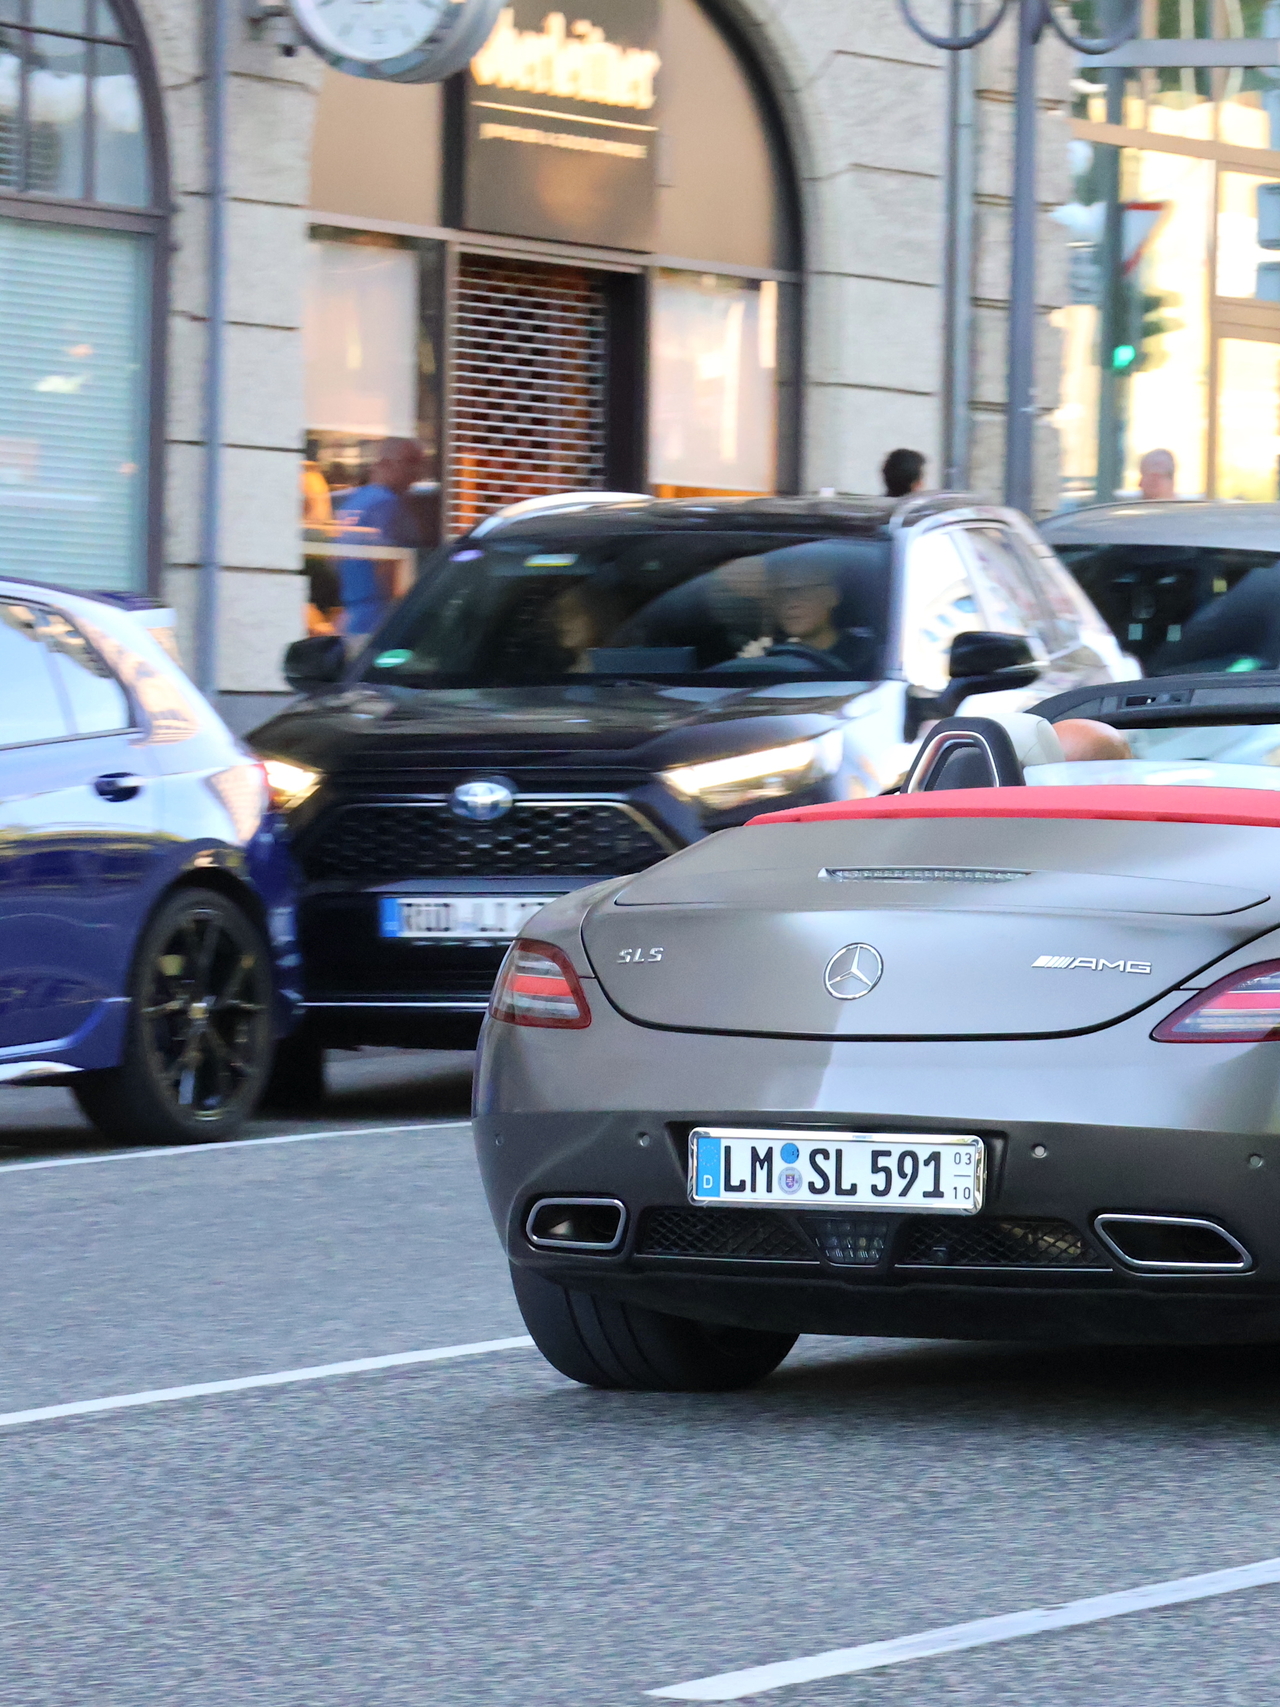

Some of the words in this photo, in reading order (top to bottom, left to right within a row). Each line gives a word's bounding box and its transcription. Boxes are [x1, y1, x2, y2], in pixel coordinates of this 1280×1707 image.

[617, 947, 664, 963] SLS
[1069, 957, 1151, 974] AMG
[953, 1152, 972, 1166] 03
[724, 1145, 773, 1193] LM
[808, 1148, 858, 1196] SL
[871, 1150, 945, 1198] 591
[703, 1174, 713, 1189] D
[953, 1186, 971, 1200] 10
